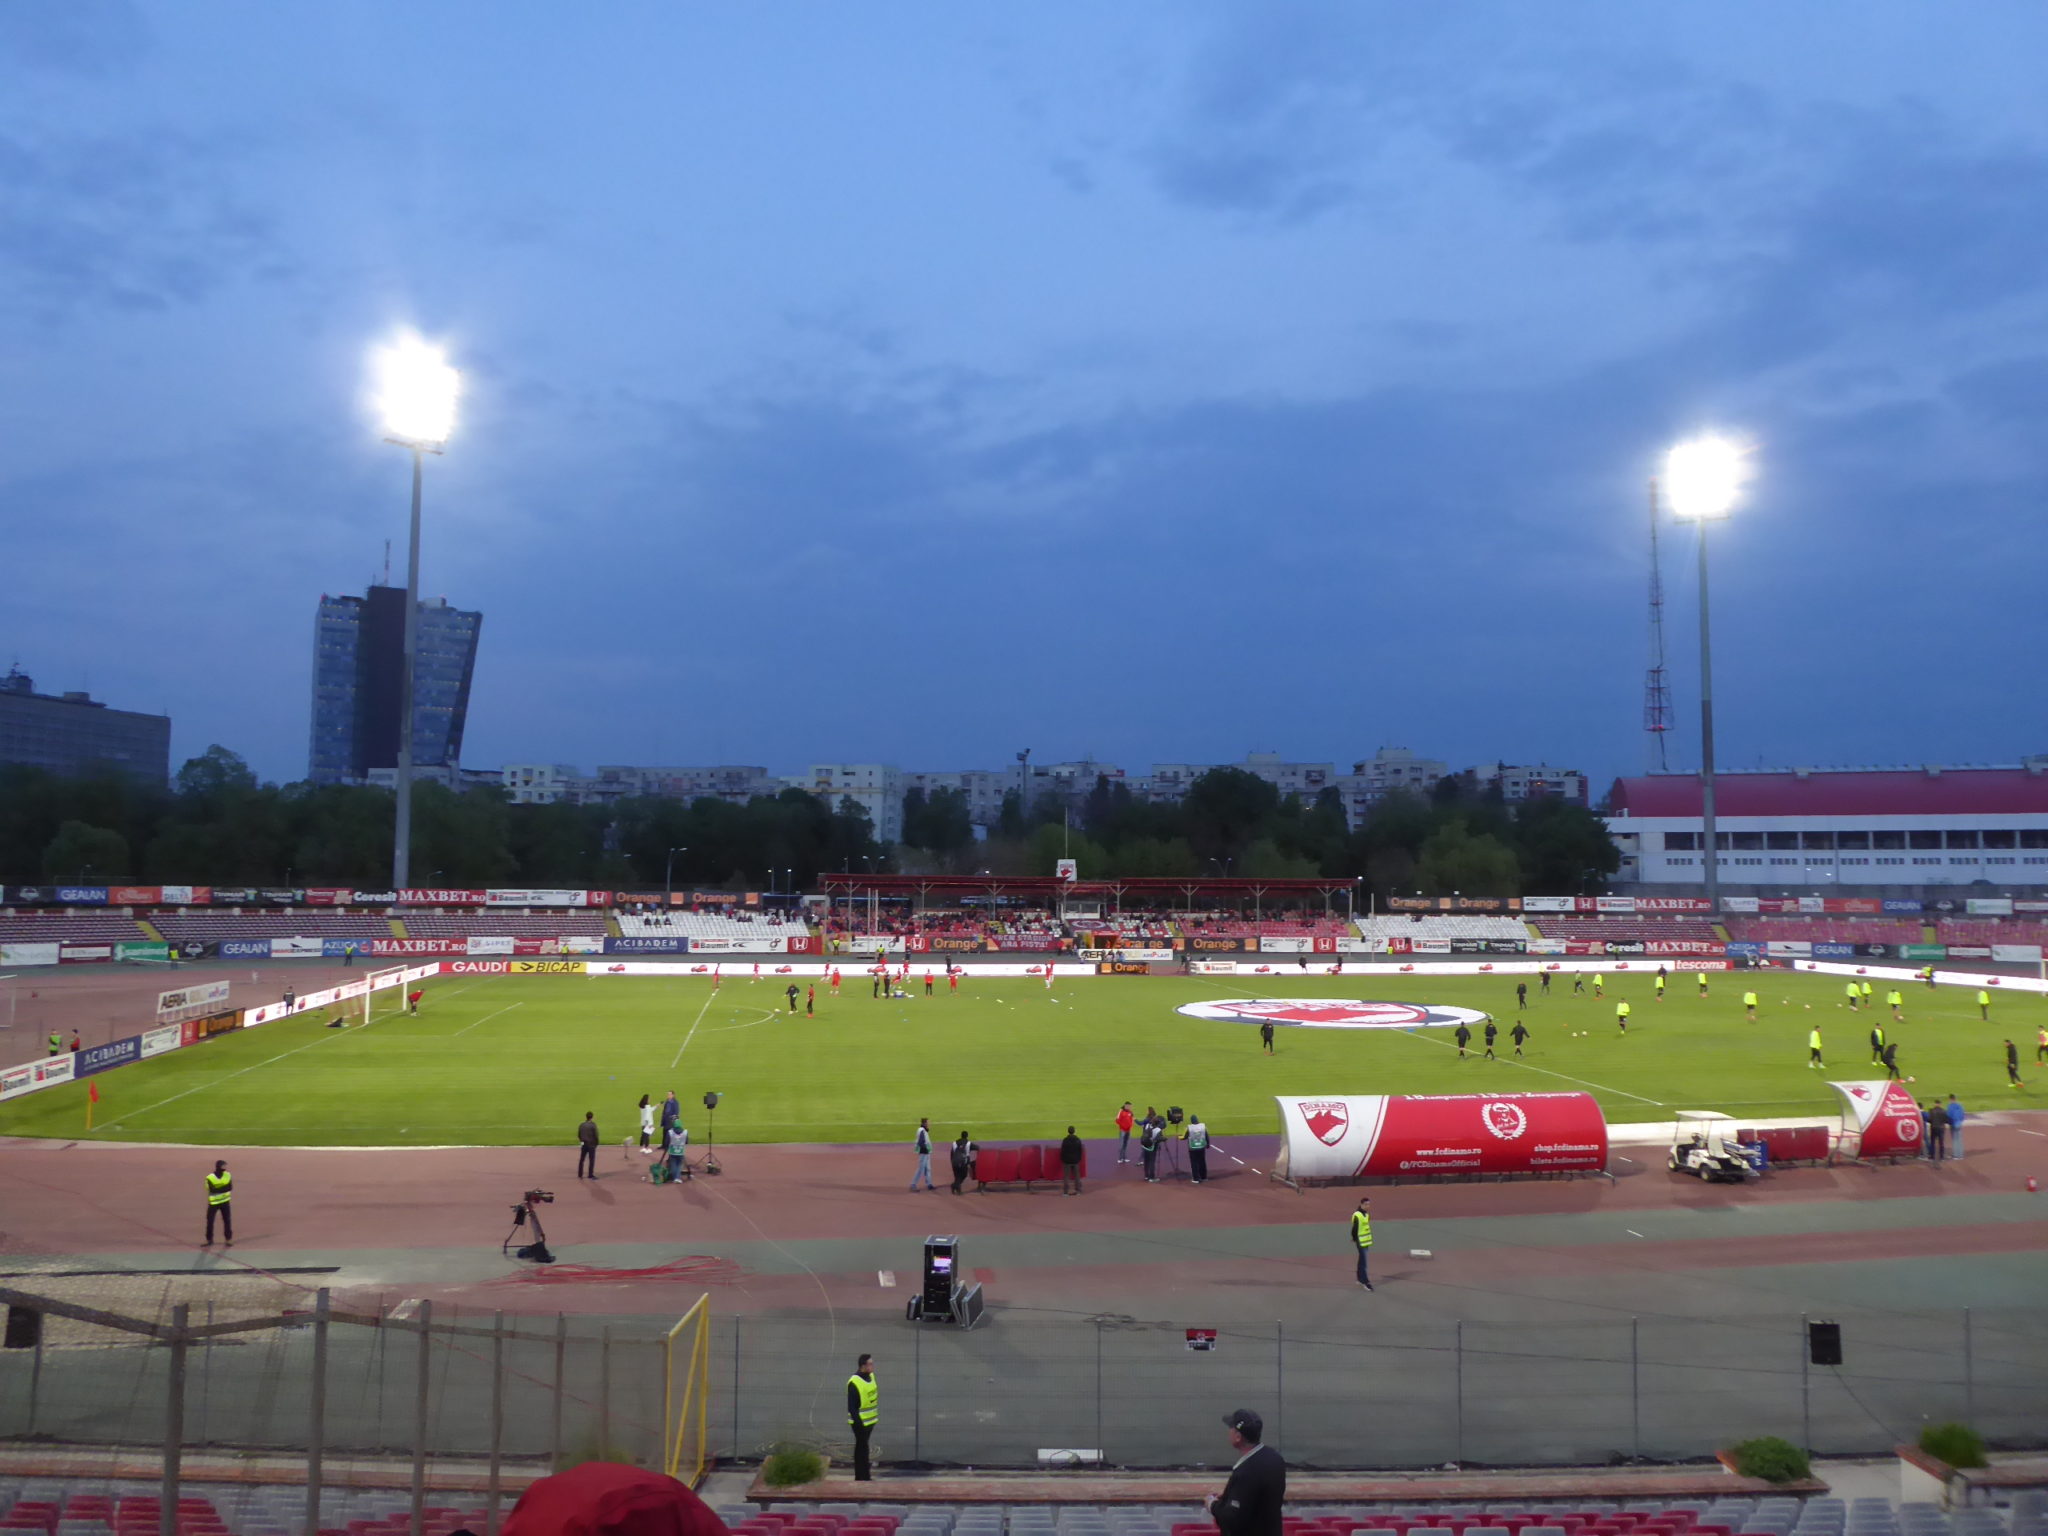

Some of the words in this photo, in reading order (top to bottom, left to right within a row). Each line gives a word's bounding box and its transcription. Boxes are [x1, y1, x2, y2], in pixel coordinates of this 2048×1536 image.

[60, 889, 106, 901] GEALAN
[399, 890, 485, 902] MAXBET.RO
[616, 892, 662, 904] Orange
[692, 892, 737, 904] Orange
[1391, 897, 1432, 909] Orange
[1458, 897, 1500, 909] Orange
[1636, 898, 1711, 909] MAXBET.RO
[223, 943, 268, 954] GEALAN
[372, 940, 467, 952] MAXBET.RO
[614, 939, 678, 947] ACIBADEM
[933, 938, 978, 951] Orange
[1193, 938, 1239, 950] Orange
[1645, 941, 1726, 953] MAXBET.RO
[536, 962, 581, 972] BICAP
[1676, 960, 1727, 970] tescoma
[1303, 1101, 1344, 1111] DINAMO
[1416, 1148, 1482, 1156] www.fcdinamo.ro
